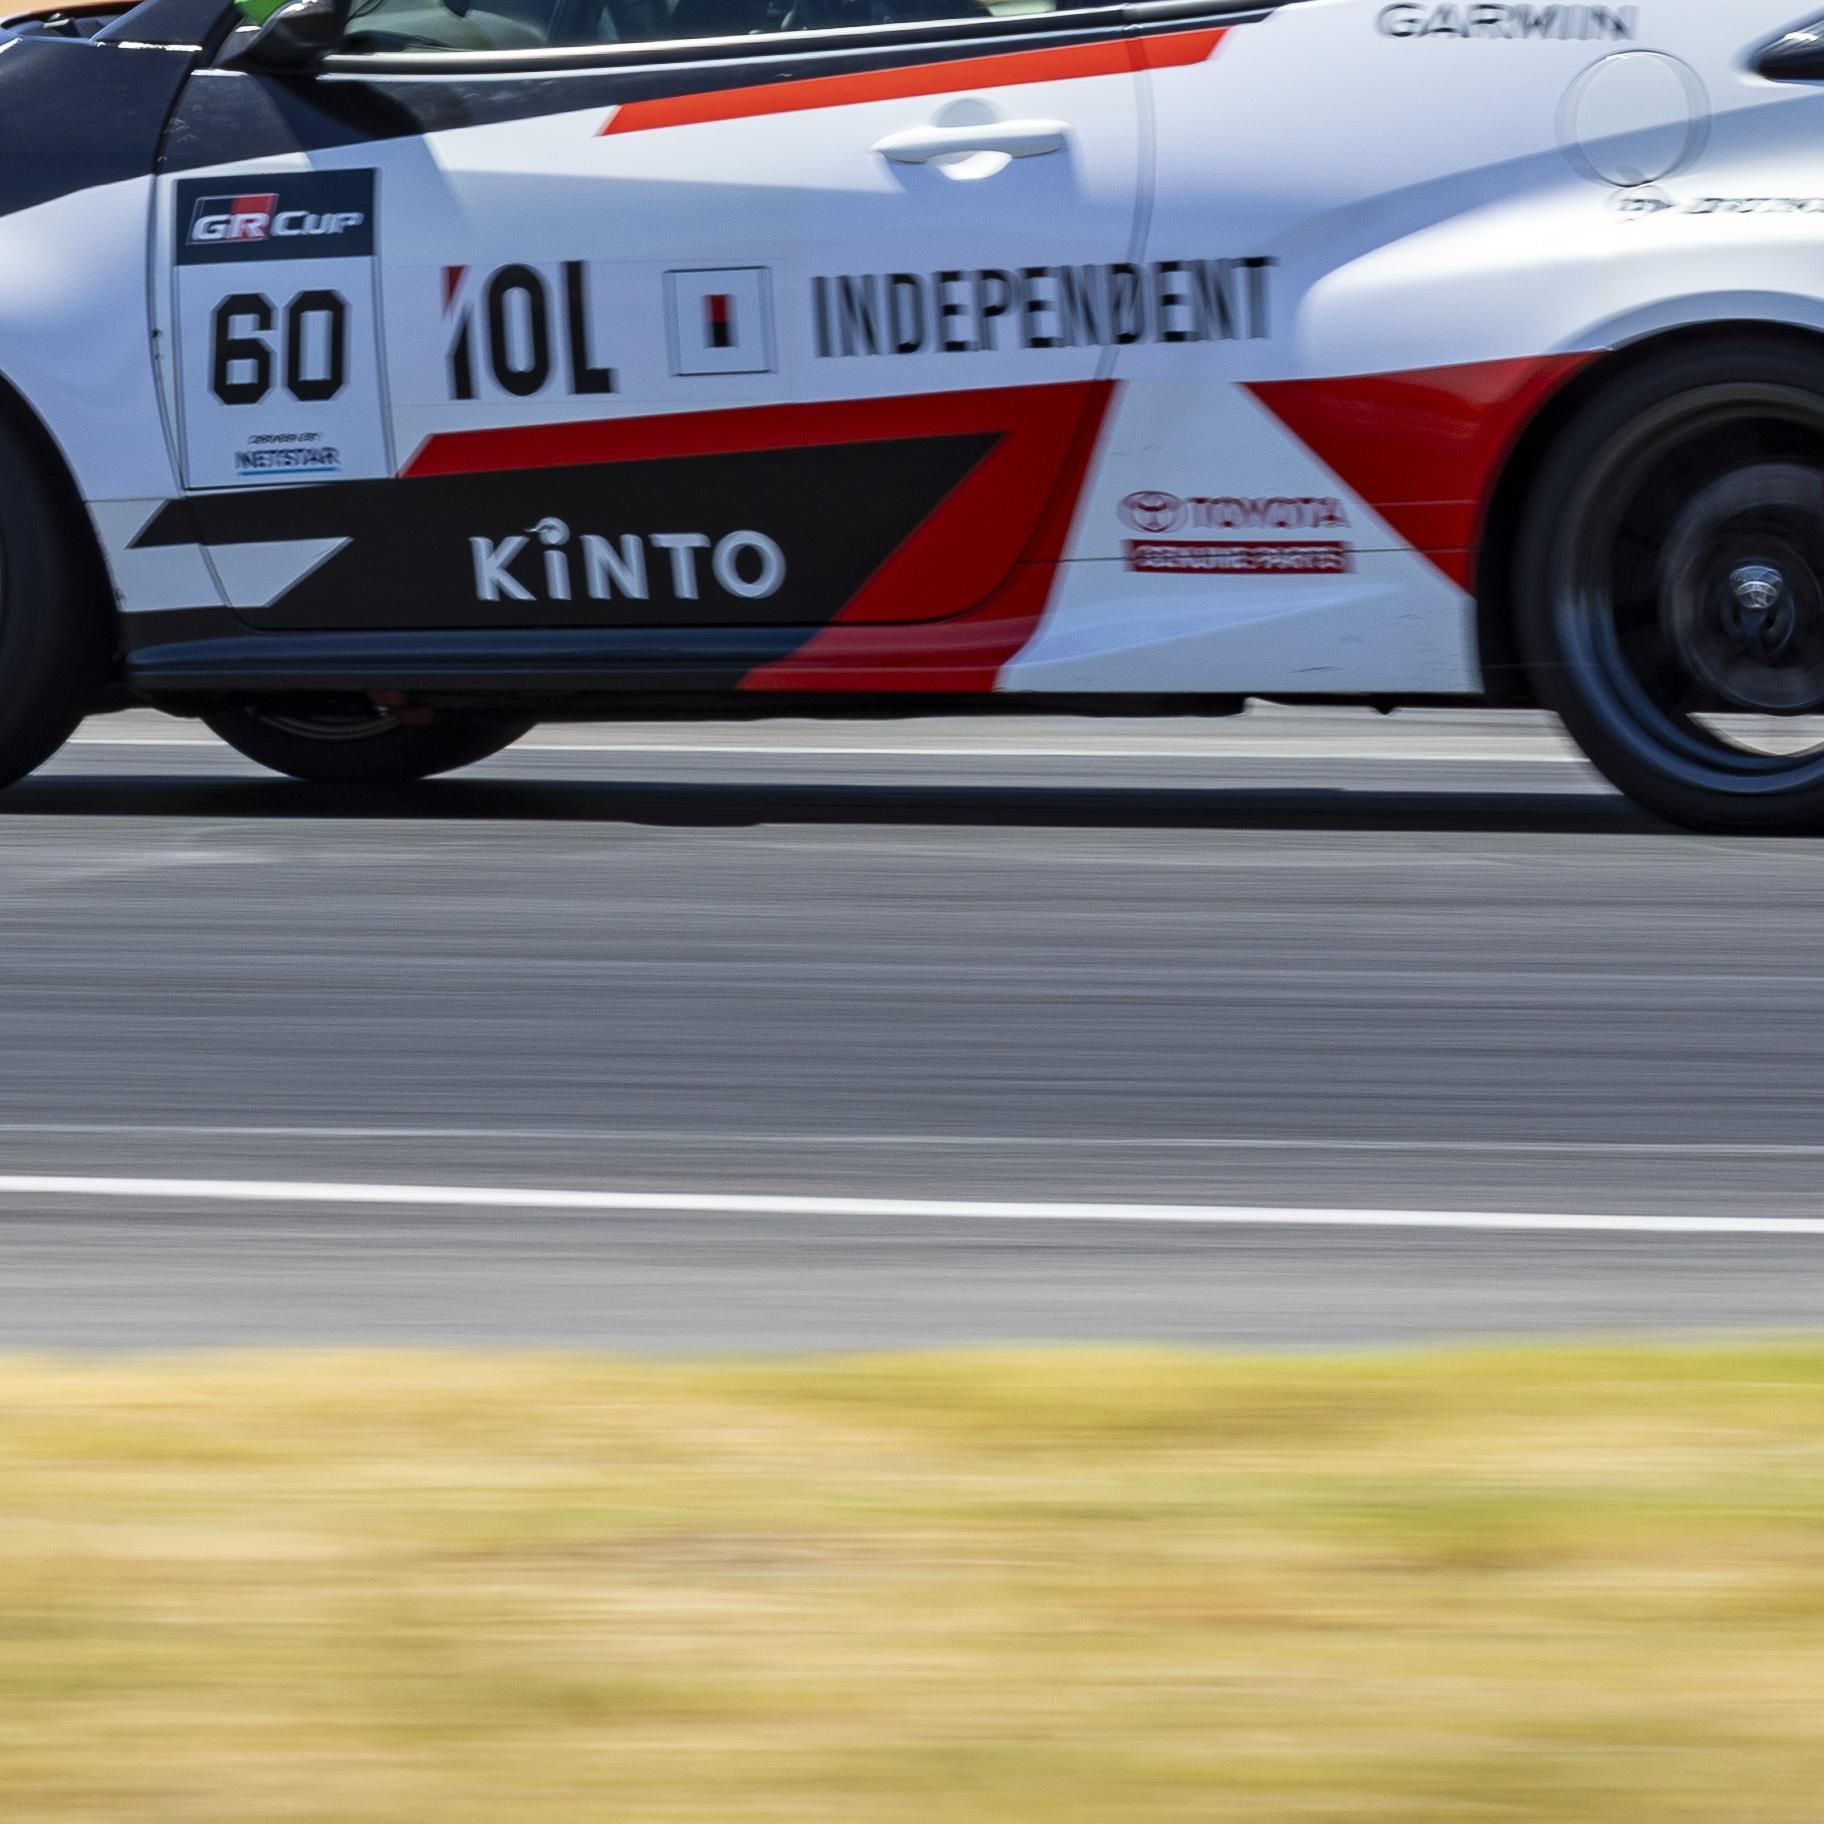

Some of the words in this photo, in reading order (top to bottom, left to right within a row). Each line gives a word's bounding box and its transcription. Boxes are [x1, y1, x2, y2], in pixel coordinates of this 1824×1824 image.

[1375, 2, 1640, 41] GARMIN
[191, 212, 273, 242] GR
[441, 259, 621, 400] IOL
[810, 256, 1279, 358] INDEPENDENT
[207, 290, 352, 405] 60
[1186, 496, 1352, 529] TOYOTA
